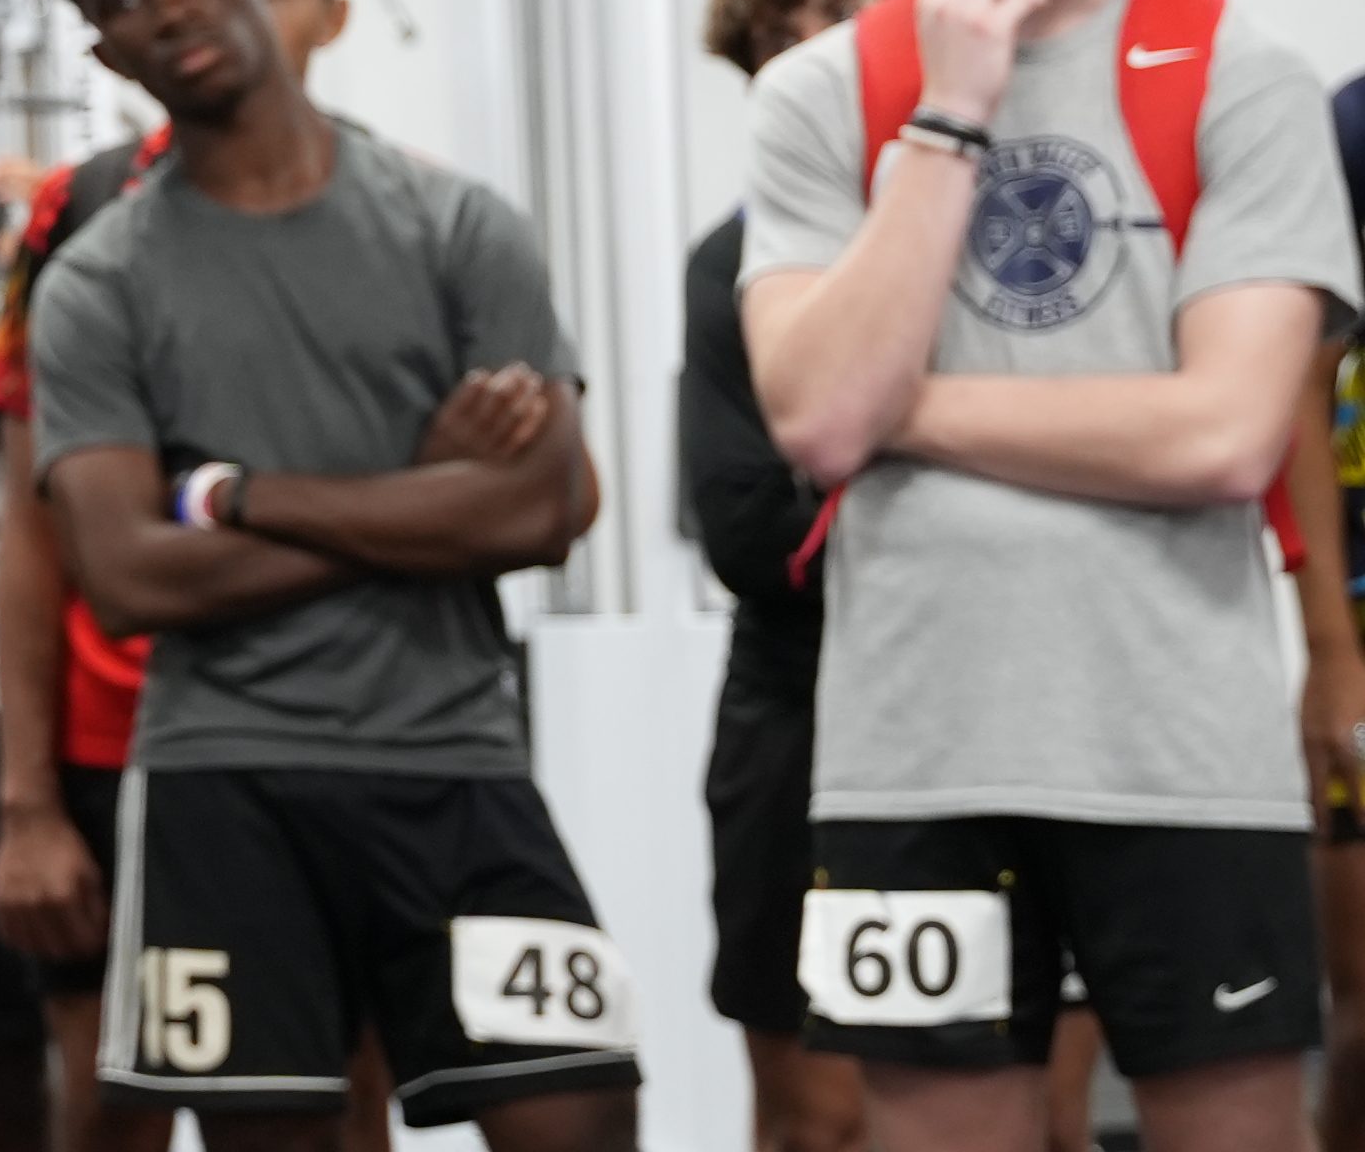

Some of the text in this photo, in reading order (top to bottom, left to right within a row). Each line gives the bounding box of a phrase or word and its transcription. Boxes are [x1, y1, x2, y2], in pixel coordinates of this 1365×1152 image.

[501, 947, 604, 1020] 48
[847, 920, 958, 997] 60
[138, 946, 232, 1073] 15
